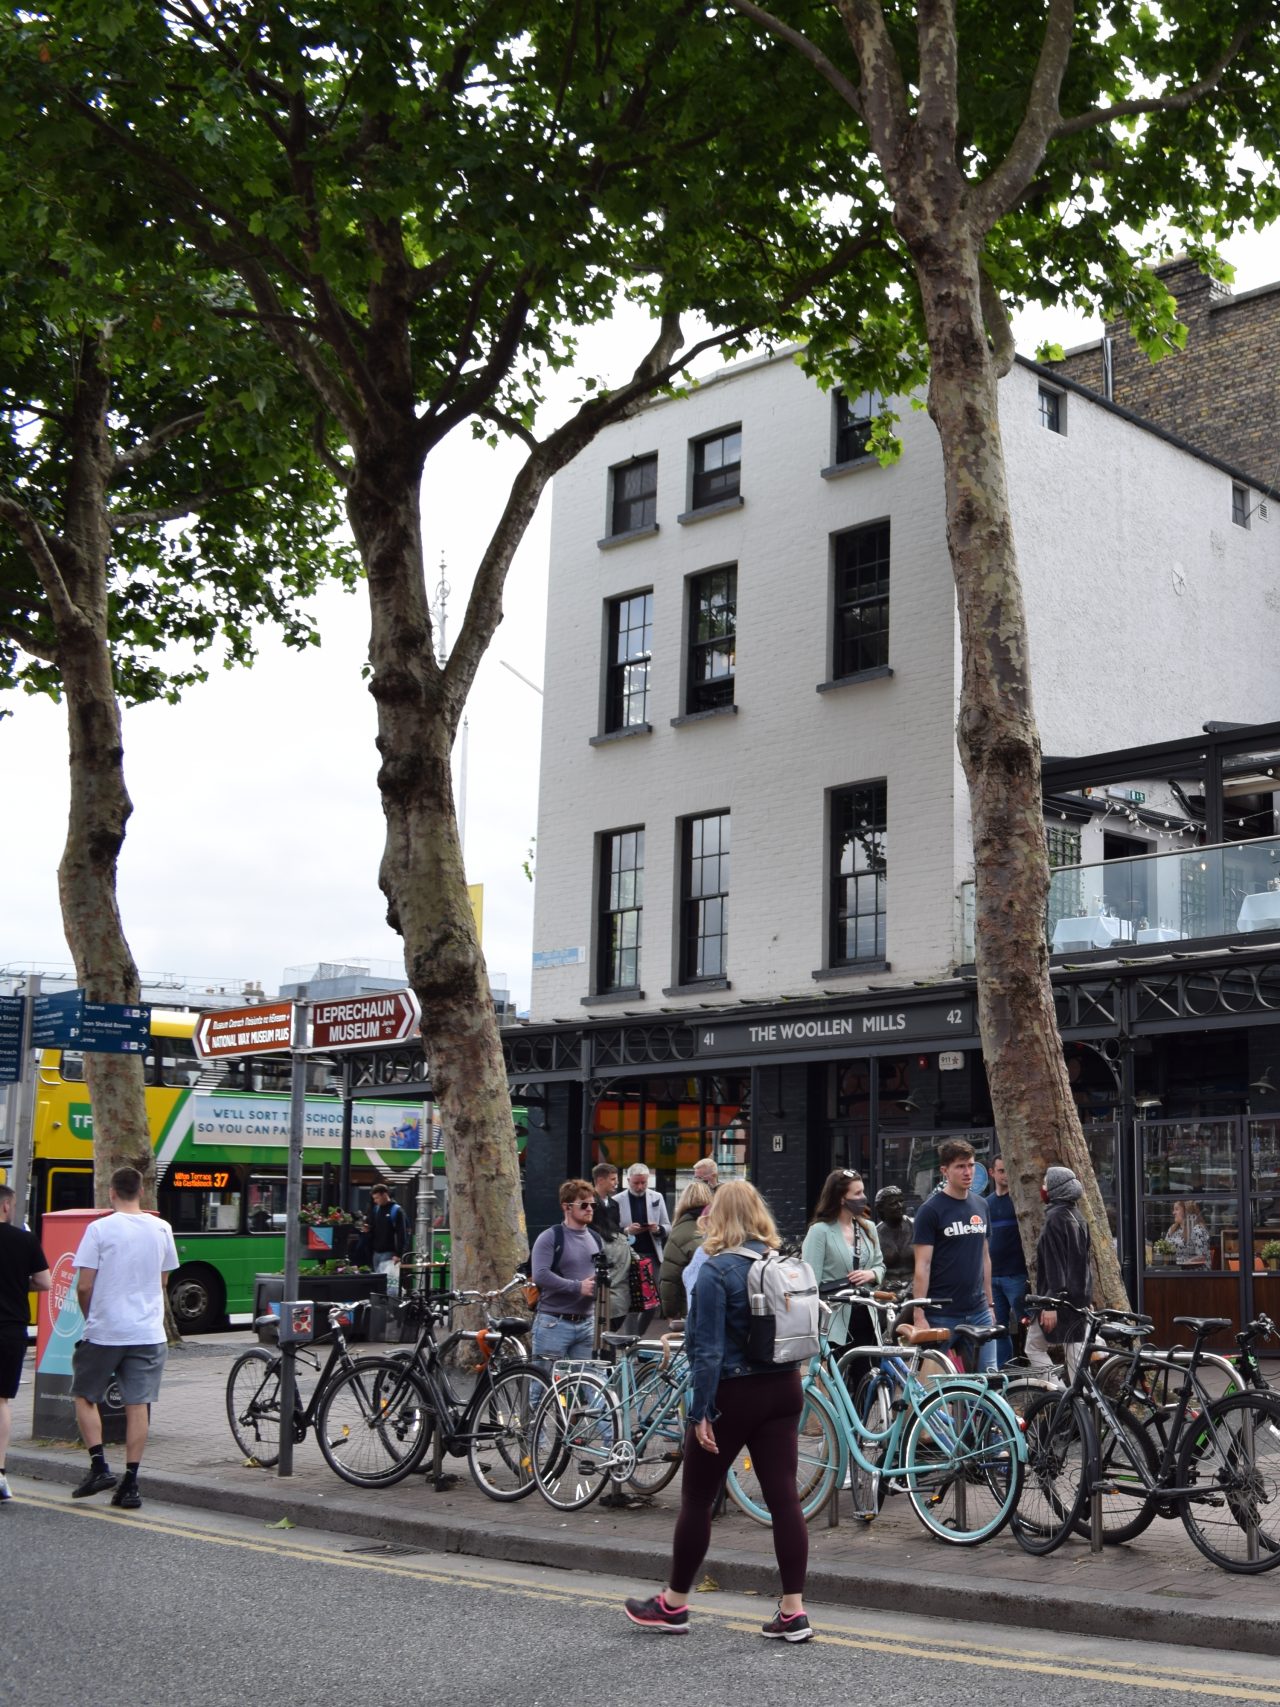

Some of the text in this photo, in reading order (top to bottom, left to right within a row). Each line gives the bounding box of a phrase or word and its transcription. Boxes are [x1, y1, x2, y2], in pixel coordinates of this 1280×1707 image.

[316, 999, 395, 1025] LEPRECHAUN
[329, 1021, 380, 1042] MUSEUM
[704, 1009, 962, 1046] 41 THE WOOLLEN MILLS 42
[212, 1027, 290, 1048] NATIONAL WAX MUSEUM PLUS
[213, 1108, 245, 1119] WE'LL
[249, 1110, 278, 1121] SORT
[305, 1113, 344, 1124] SCHOO
[353, 1115, 374, 1125] BAG
[197, 1123, 214, 1133] SO
[218, 1123, 242, 1134] YOU
[245, 1124, 270, 1135] CAN
[305, 1127, 326, 1137] THE
[328, 1128, 363, 1139] BECH
[365, 1129, 386, 1139] BAG
[213, 1172, 229, 1188] 37
[943, 1221, 987, 1238] elless
[54, 1296, 78, 1314] TOWN
